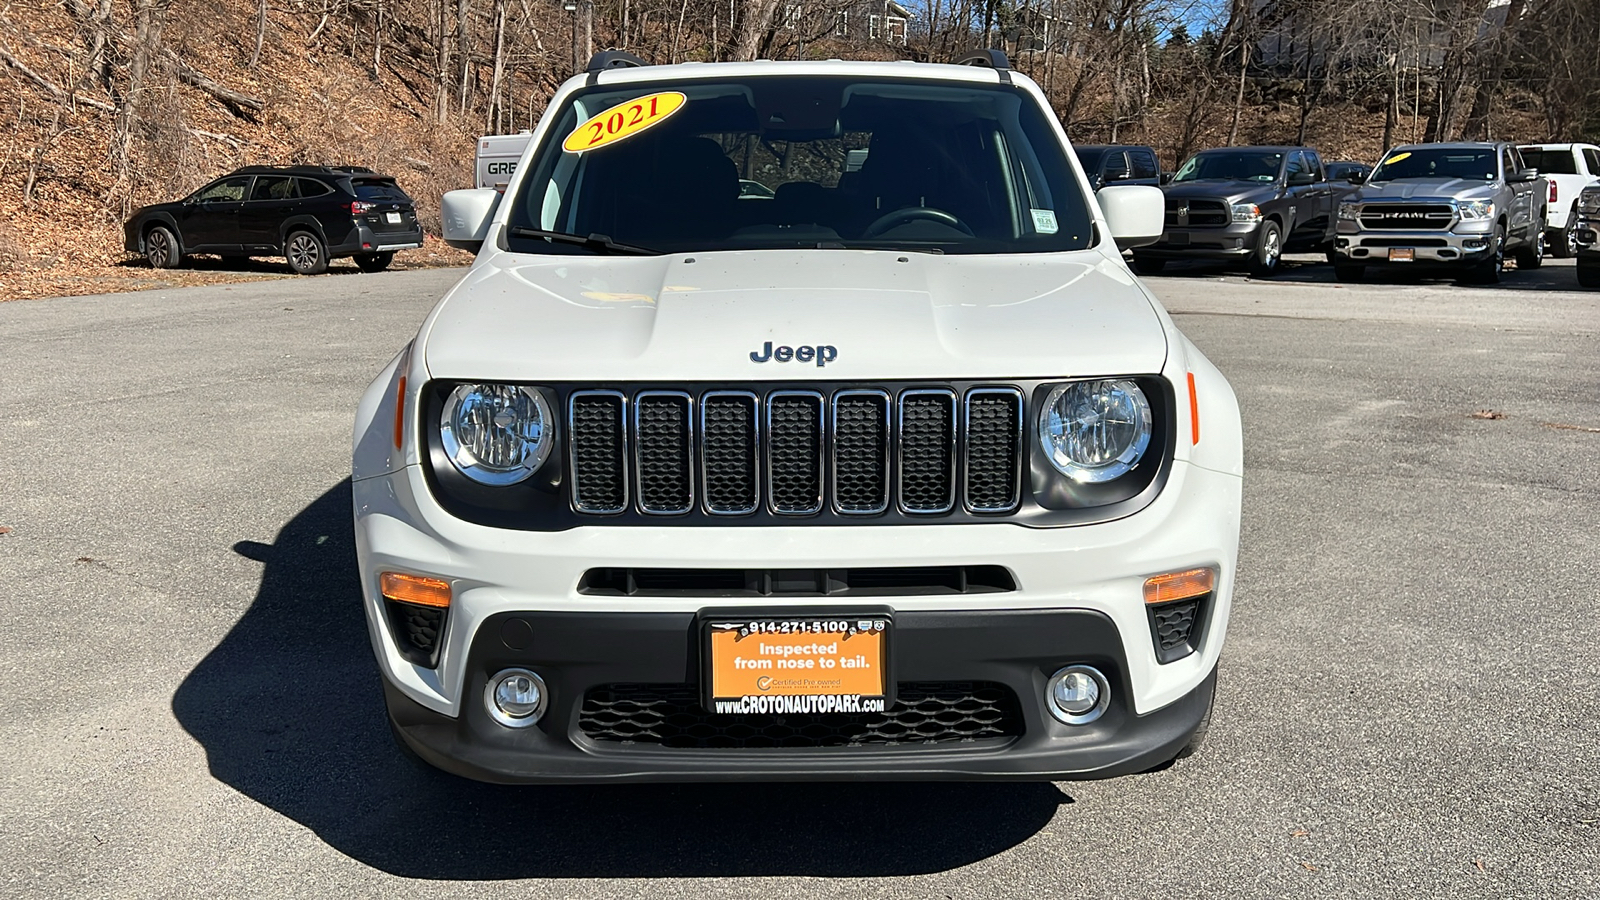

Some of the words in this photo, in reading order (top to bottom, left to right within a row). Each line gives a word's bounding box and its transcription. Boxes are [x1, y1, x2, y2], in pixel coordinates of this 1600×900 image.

[588, 97, 660, 146] 2021
[749, 341, 838, 368] Jeep
[749, 621, 849, 633] 914-271-5100
[759, 642, 837, 657] Inspected
[734, 657, 772, 669] from
[777, 658, 815, 669] nose
[818, 657, 836, 668] to
[839, 655, 870, 668] tail.
[772, 678, 802, 686] Certified
